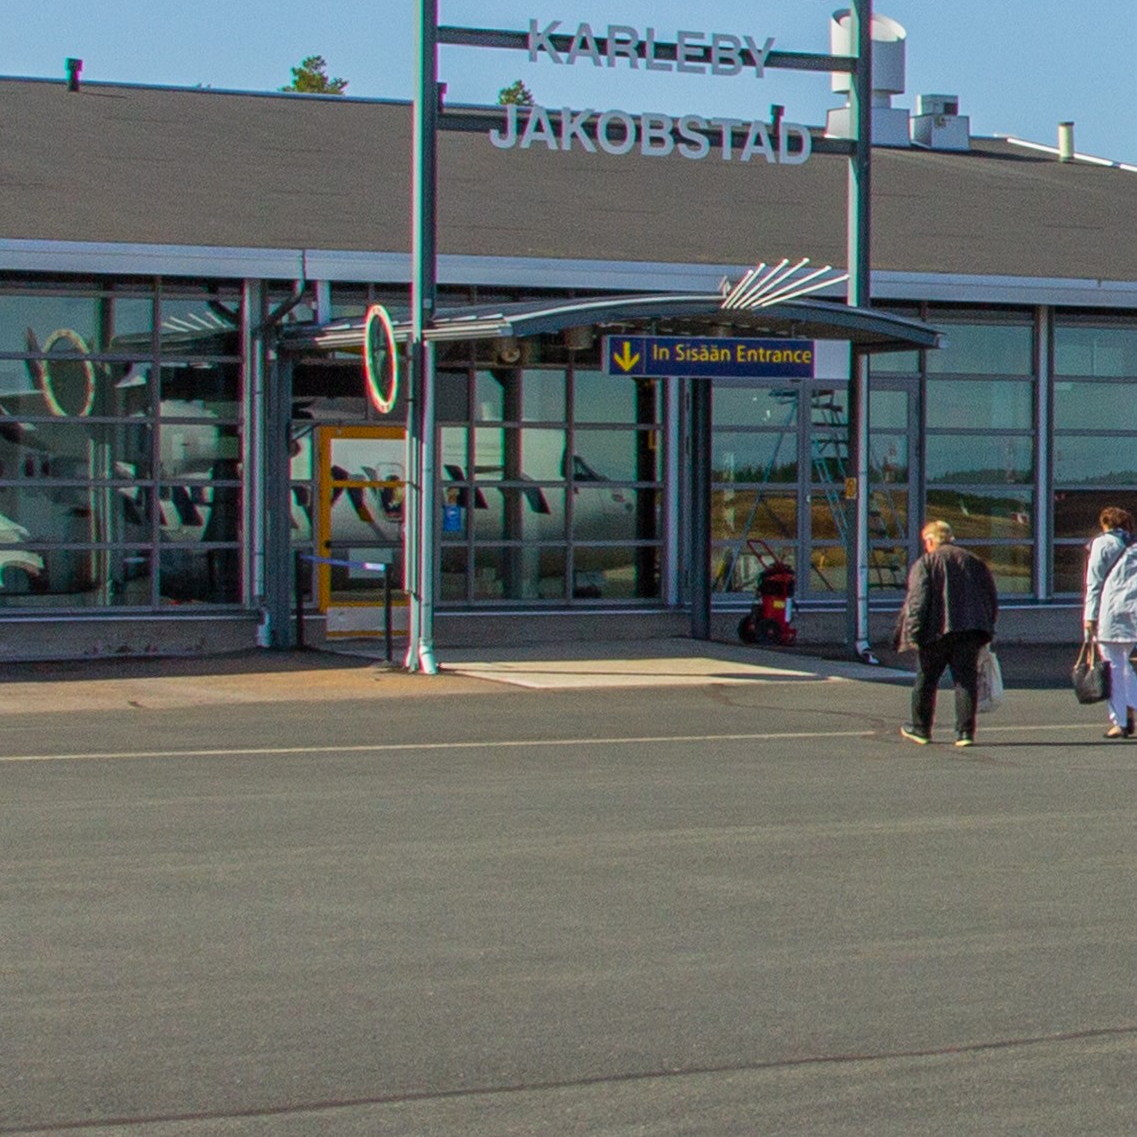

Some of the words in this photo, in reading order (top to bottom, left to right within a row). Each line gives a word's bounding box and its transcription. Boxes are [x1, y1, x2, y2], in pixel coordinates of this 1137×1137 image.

[527, 18, 776, 79] KARLEBY
[488, 104, 813, 165] JAKOBSTAD
[652, 344, 670, 361] In
[675, 343, 731, 362] Sisään
[736, 344, 812, 364] Entrance
